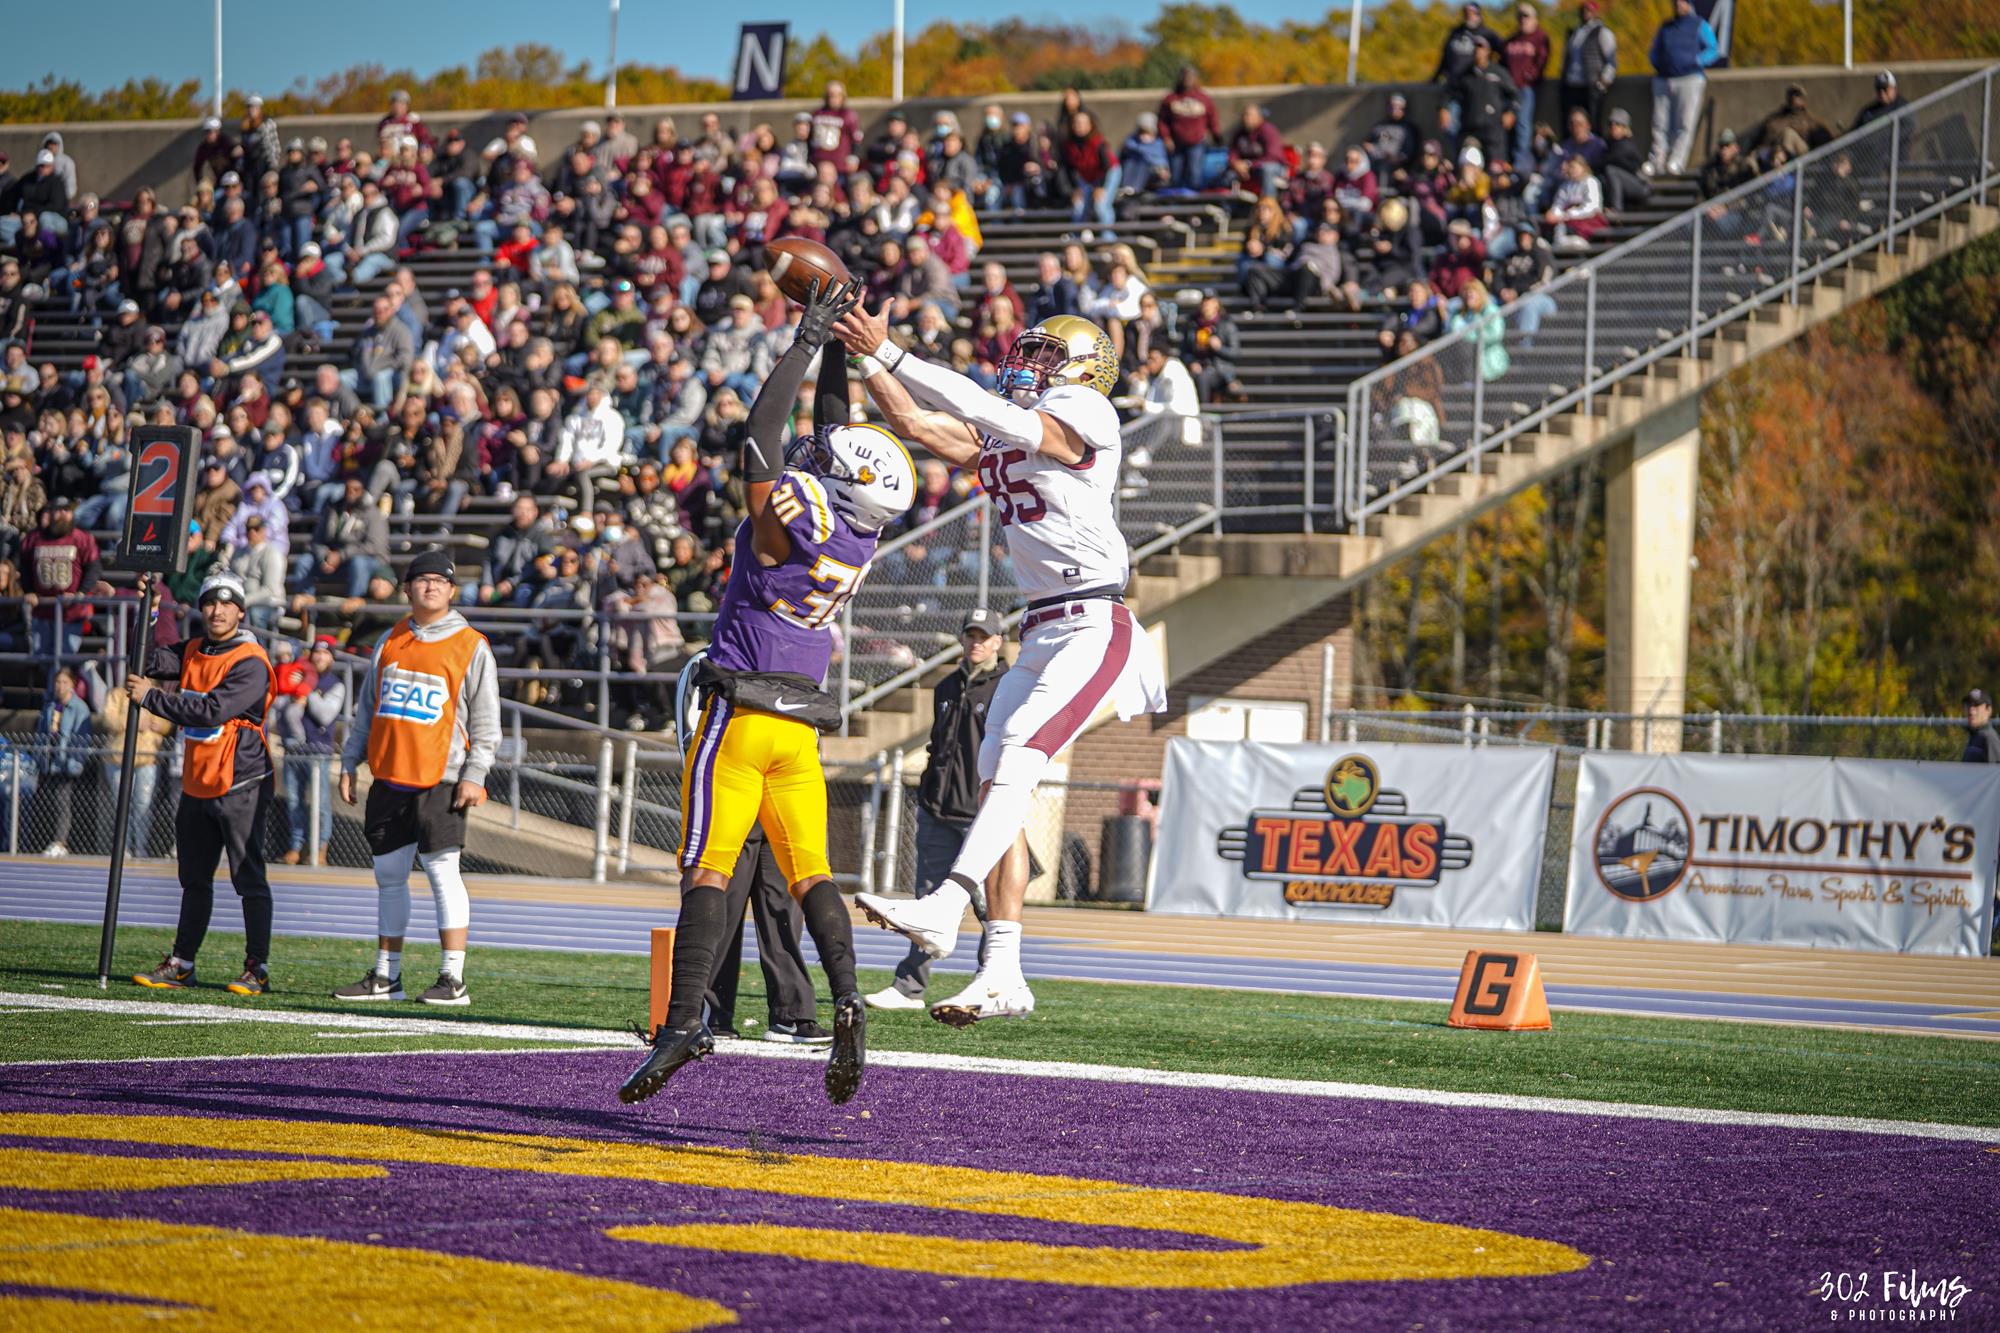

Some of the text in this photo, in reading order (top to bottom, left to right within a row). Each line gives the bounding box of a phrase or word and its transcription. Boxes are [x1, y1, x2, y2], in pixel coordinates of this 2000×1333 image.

[736, 32, 784, 92] N
[132, 441, 180, 515] 2
[978, 448, 1047, 527] 85
[380, 680, 442, 711] PSAC
[1255, 817, 1439, 879] TEXAS
[1685, 872, 1766, 896] American
[1767, 874, 1814, 901] Fare,
[1820, 877, 1877, 911] Sports
[1883, 881, 1904, 903] &
[1463, 953, 1519, 1016] G
